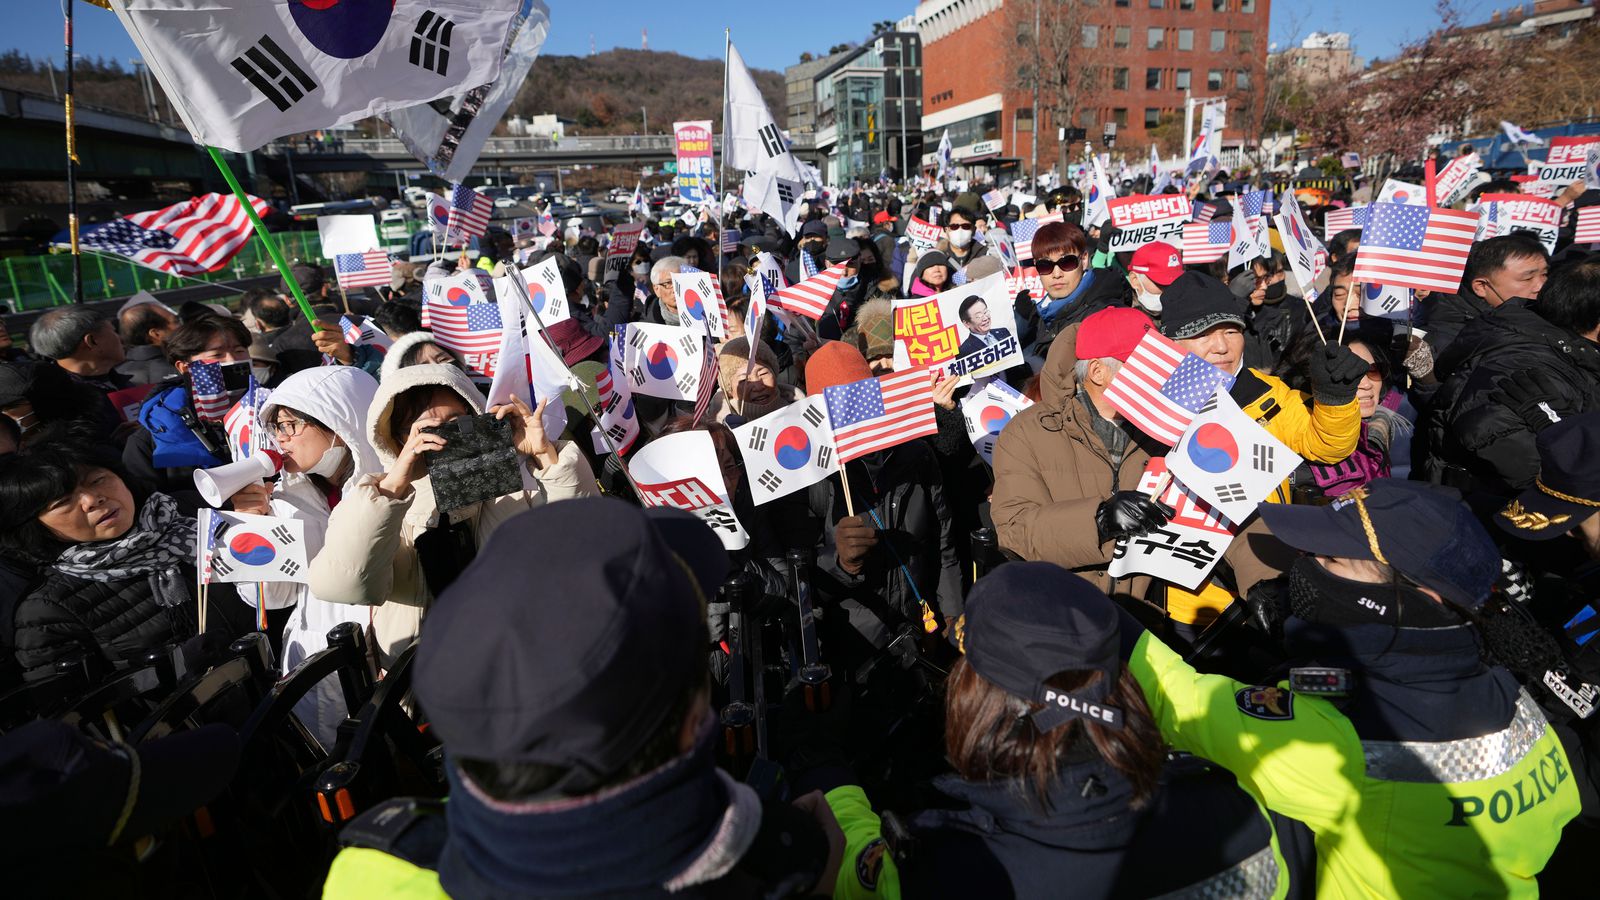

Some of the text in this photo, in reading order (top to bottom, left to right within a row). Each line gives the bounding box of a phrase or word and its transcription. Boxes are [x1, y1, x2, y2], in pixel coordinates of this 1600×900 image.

[1112, 195, 1189, 225] 탄핵반대
[1111, 226, 1158, 246] 이재명
[894, 302, 940, 337] 내란
[908, 326, 960, 365] 수괴
[948, 337, 1018, 377] 체포하라
[1045, 690, 1115, 723] POLICE
[1548, 676, 1589, 713] POLICE
[1444, 745, 1569, 828] POLICE
